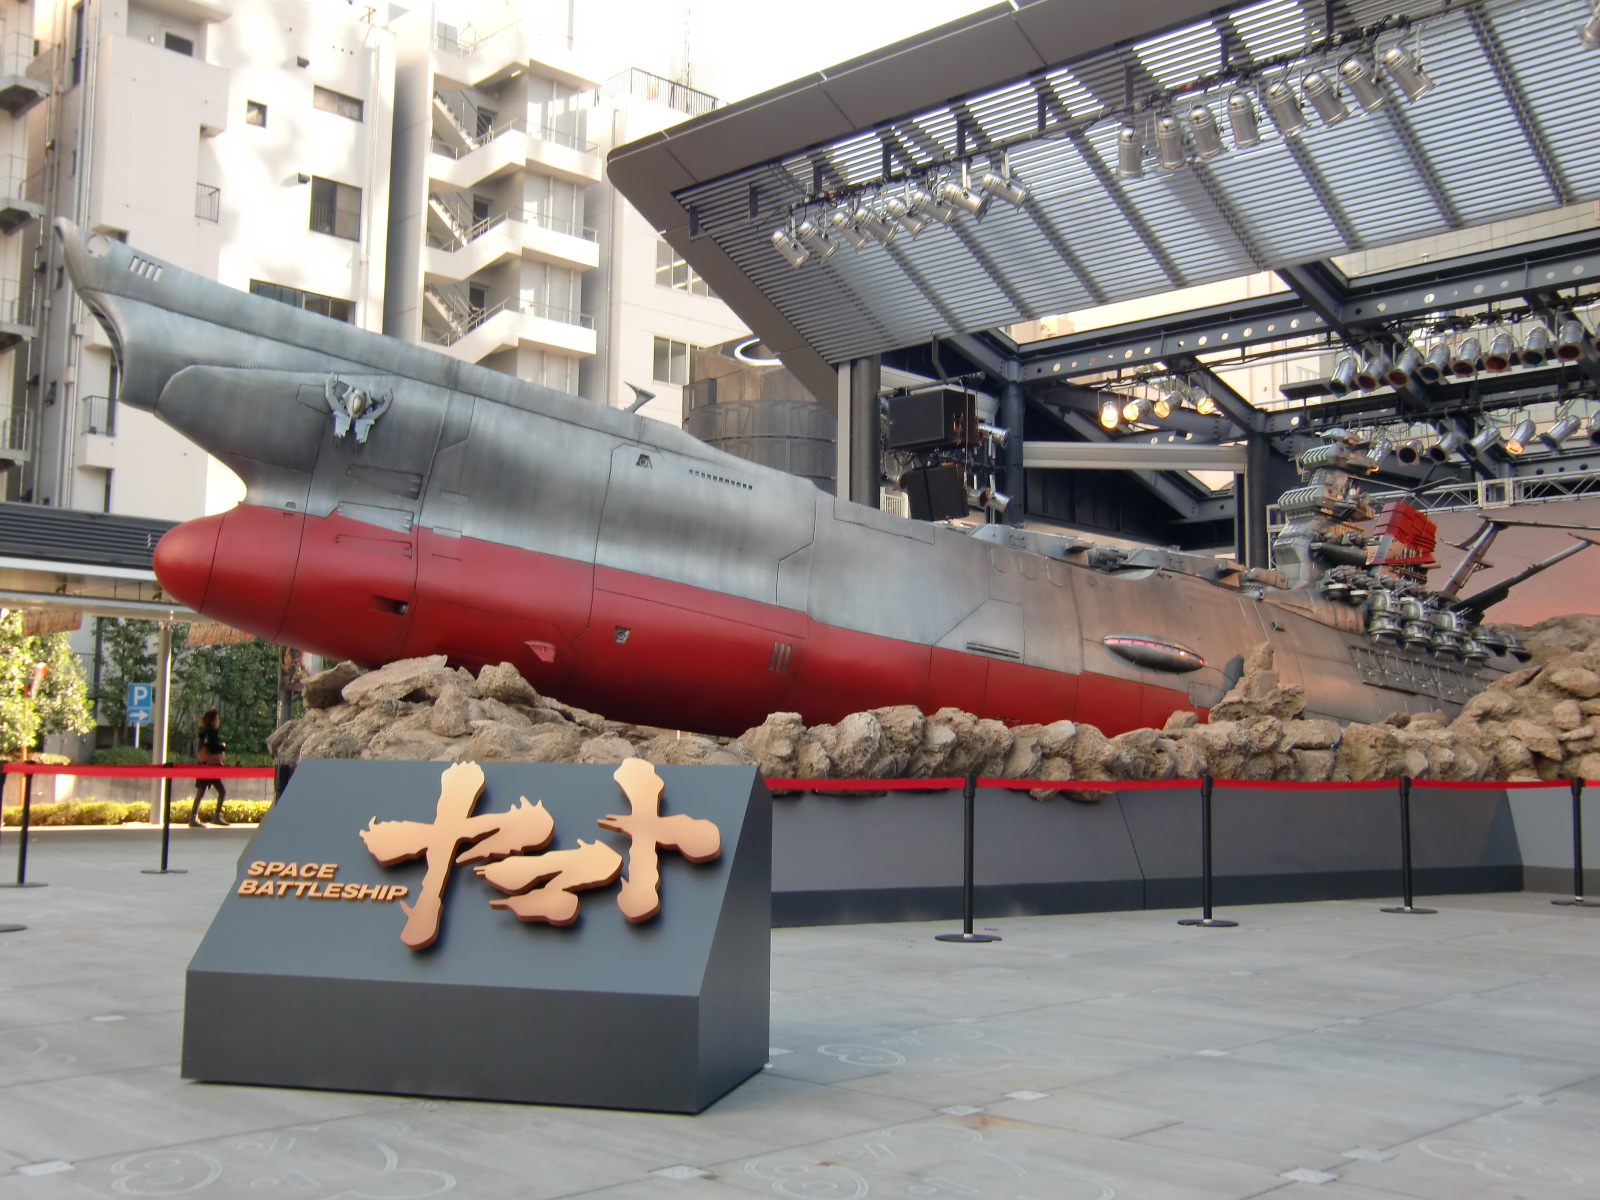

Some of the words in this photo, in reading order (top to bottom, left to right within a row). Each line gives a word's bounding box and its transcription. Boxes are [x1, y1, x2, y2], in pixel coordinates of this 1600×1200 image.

[133, 686, 148, 706] P
[247, 861, 338, 880] SPACE
[237, 879, 409, 901] BATTLESHIP
